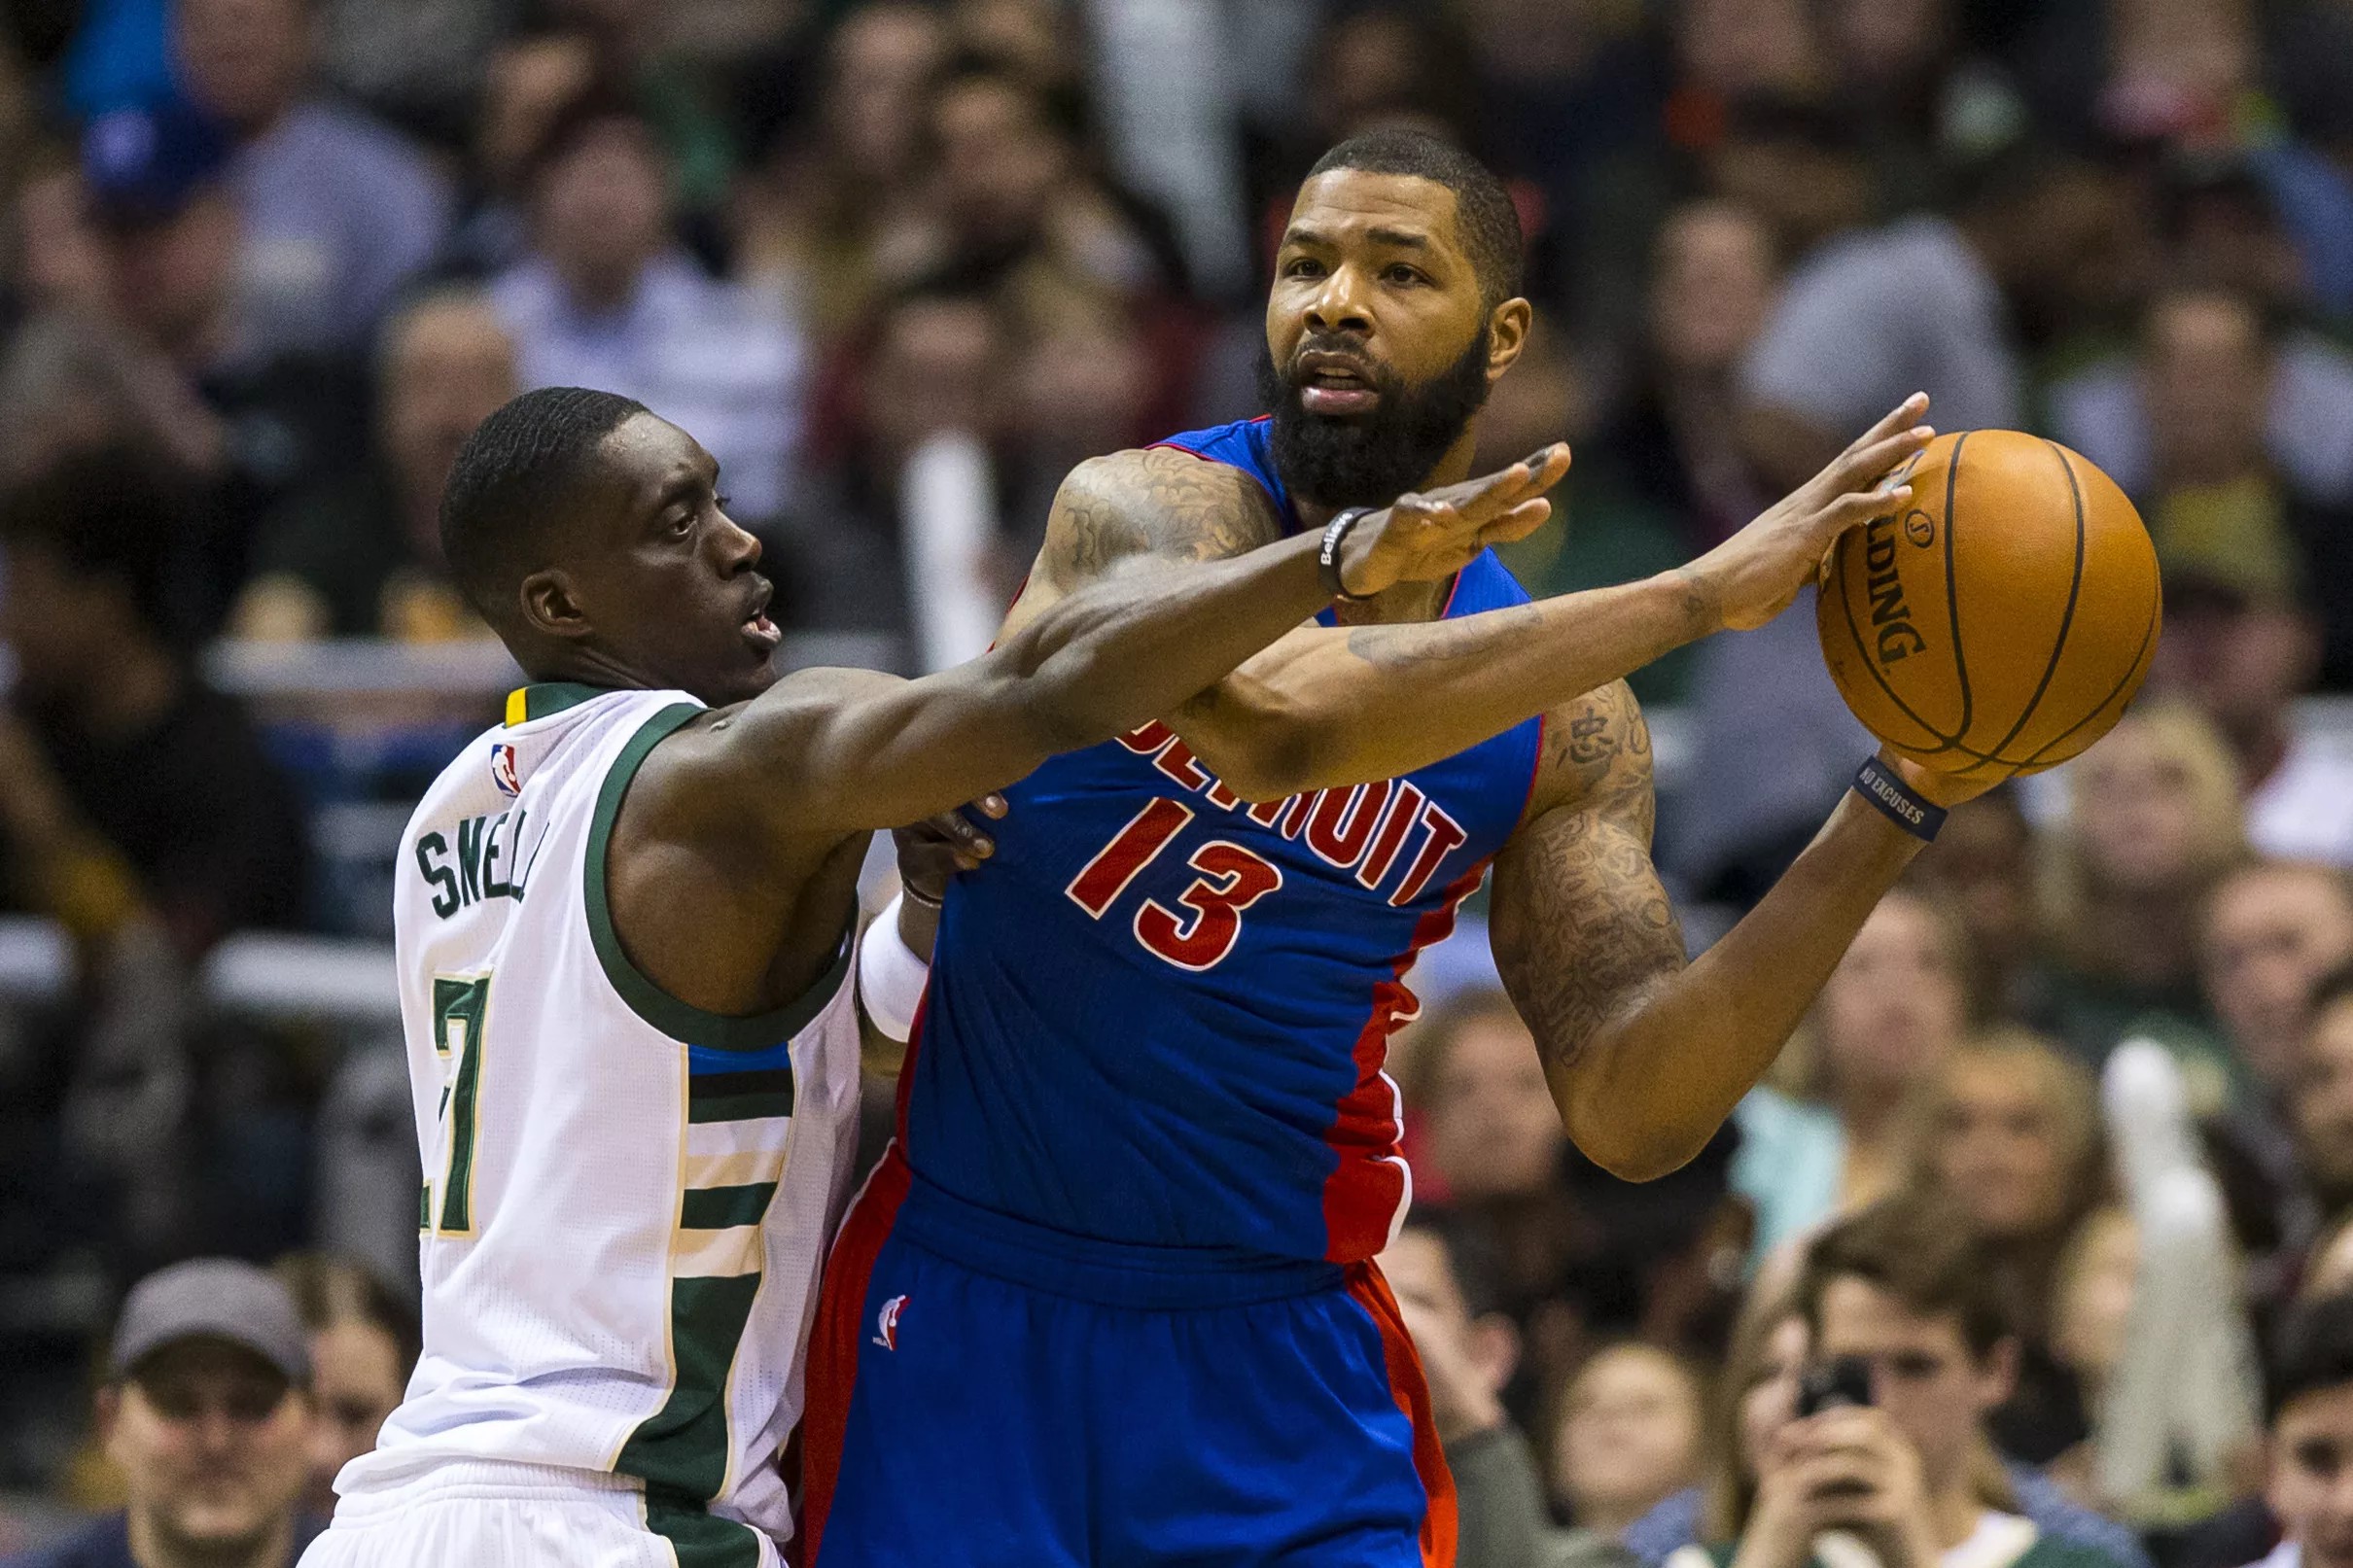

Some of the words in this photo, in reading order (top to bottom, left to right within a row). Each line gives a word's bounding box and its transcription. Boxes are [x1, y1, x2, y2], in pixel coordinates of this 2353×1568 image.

[1866, 511, 1927, 665] LDING
[415, 809, 550, 920] SNEL
[1115, 718, 1468, 907] EOIT
[1859, 766, 1877, 784] NO
[1871, 777, 1925, 825] EXCUSES
[1065, 796, 1283, 972] 13
